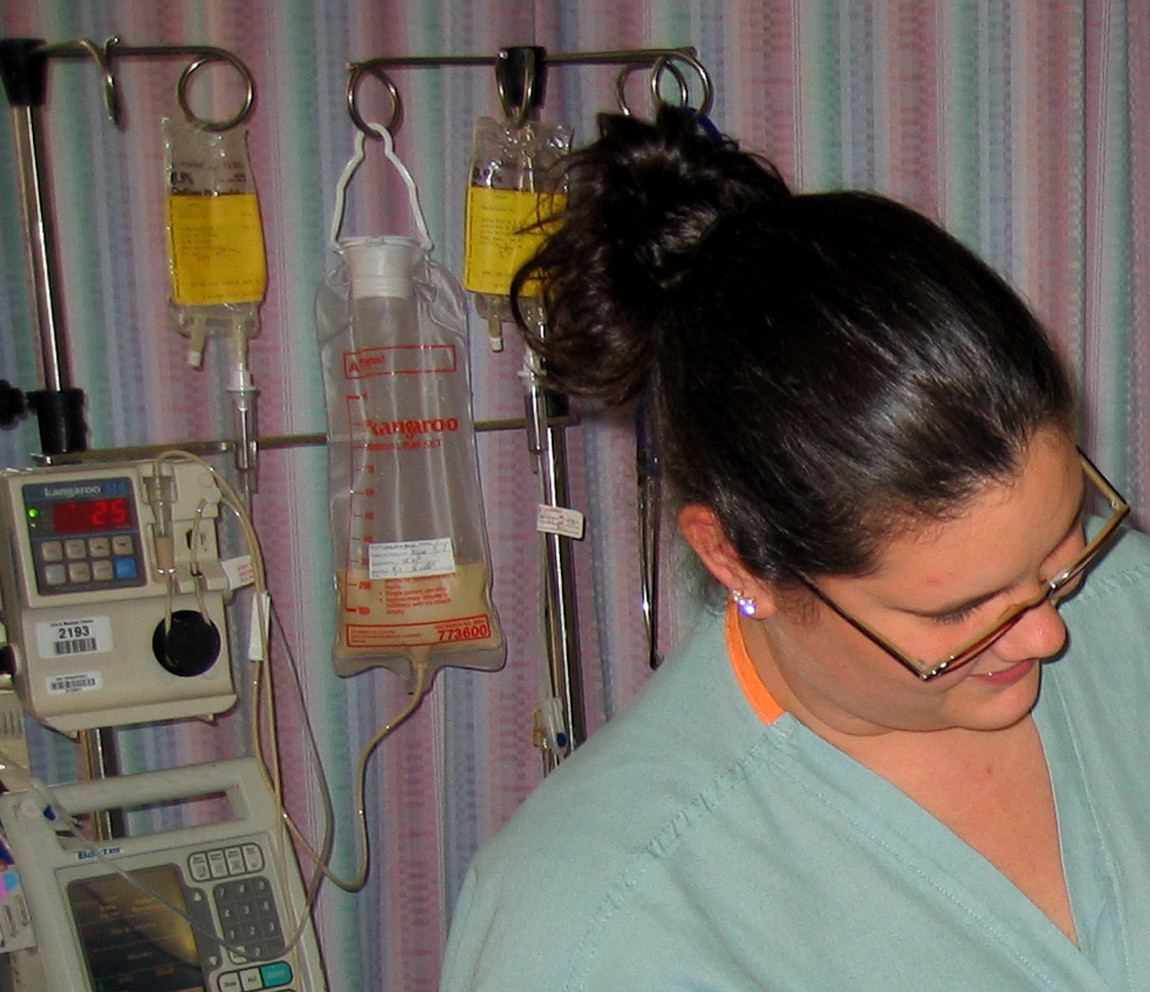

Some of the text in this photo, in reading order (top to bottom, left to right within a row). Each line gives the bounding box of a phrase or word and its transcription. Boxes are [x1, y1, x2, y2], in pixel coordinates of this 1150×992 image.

[91, 499, 127, 526] 25
[59, 626, 90, 639] 2193
[437, 624, 487, 642] 773600
